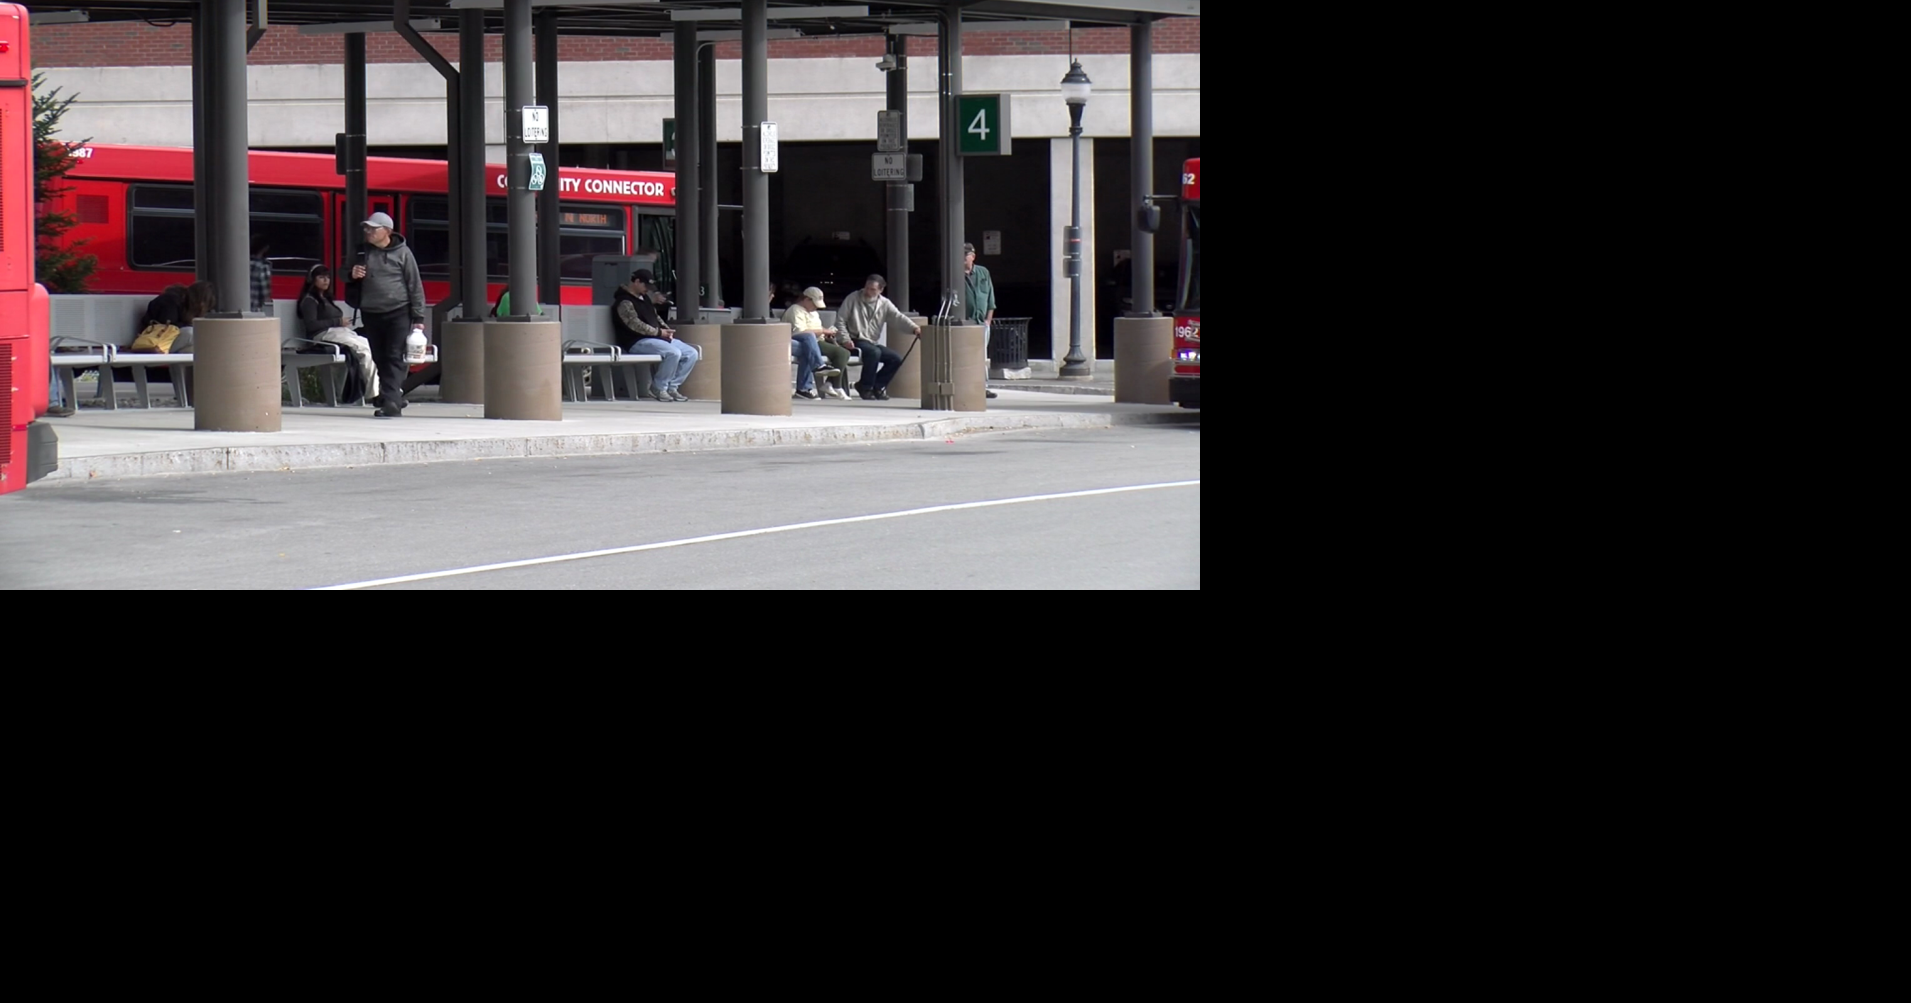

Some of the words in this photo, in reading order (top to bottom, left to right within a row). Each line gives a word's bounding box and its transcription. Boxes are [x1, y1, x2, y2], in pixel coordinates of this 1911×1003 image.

[532, 111, 540, 122] NO
[968, 108, 990, 141] 4
[524, 127, 548, 138] LOITERING
[884, 156, 893, 165] NO
[873, 168, 905, 177] LOITERING
[585, 178, 665, 197] CONNECTOR
